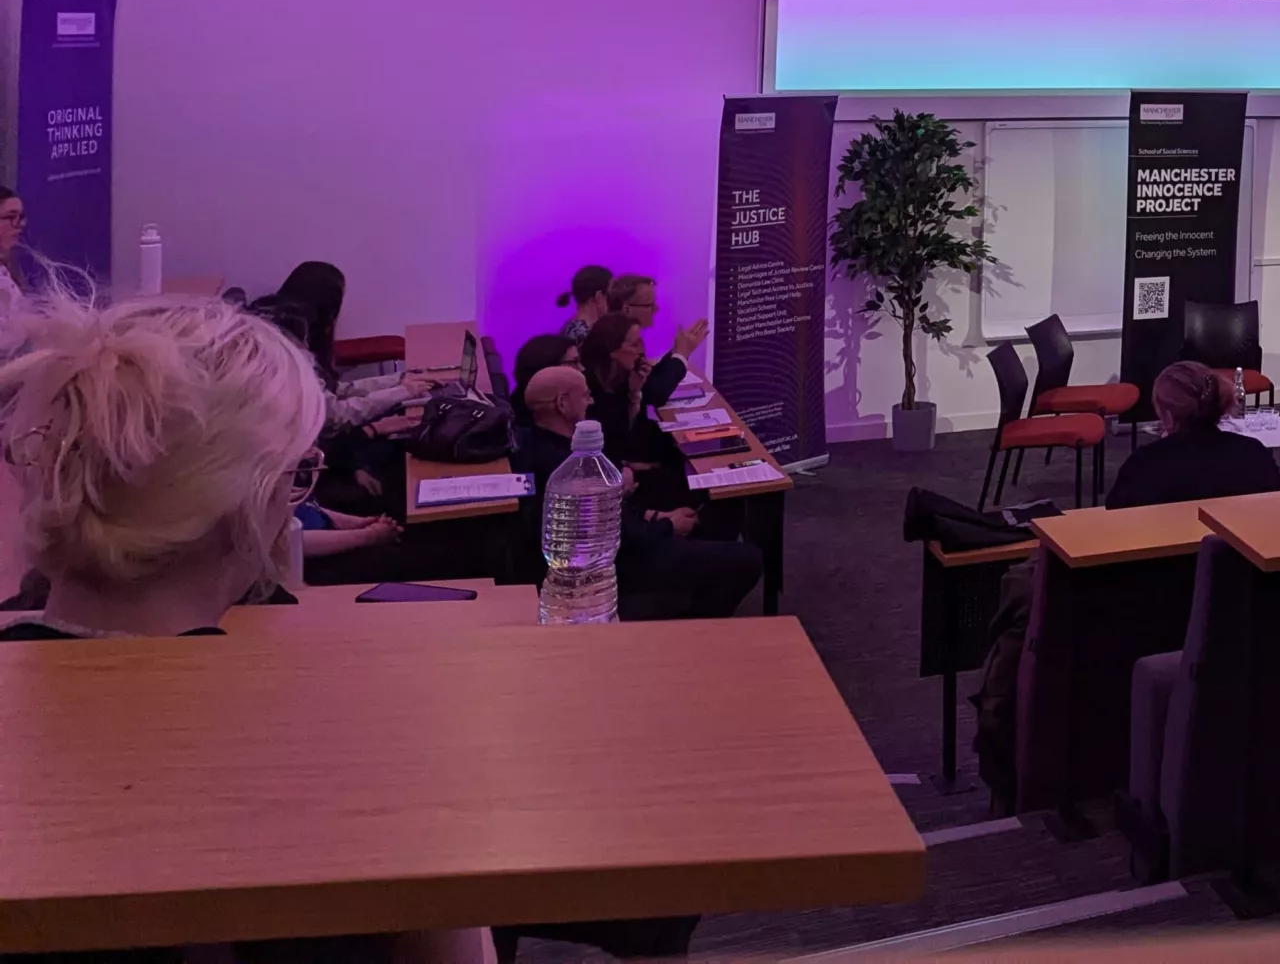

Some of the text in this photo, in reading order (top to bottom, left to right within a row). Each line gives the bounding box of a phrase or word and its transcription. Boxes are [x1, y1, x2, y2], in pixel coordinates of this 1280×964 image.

[47, 106, 103, 125] ORIGINAL
[46, 123, 103, 142] THINKING
[51, 139, 98, 160] APPLIED
[1137, 168, 1236, 183] MANCHESTER
[731, 190, 761, 205] THE
[1136, 183, 1222, 198] INNOCENCE
[1136, 198, 1201, 213] PROJECT
[731, 207, 786, 225] JUSTICE
[731, 230, 760, 246] HUB
[1135, 230, 1214, 243] Freeing the Innocent
[1135, 247, 1217, 260] Changing the System
[738, 265, 752, 273] Legal
[752, 263, 768, 271] Advice
[773, 268, 791, 276] Justice
[737, 281, 762, 290] Dementia
[737, 291, 751, 299] Legal
[795, 282, 814, 290] Justice
[737, 297, 765, 306] Manchester
[775, 293, 789, 301] Legal
[736, 303, 777, 315] Vacation Scheme
[736, 314, 757, 323] Personal
[757, 311, 777, 320] Support
[736, 323, 755, 332] Greater
[754, 319, 783, 328] Manchester
[793, 315, 812, 323] Centre
[736, 333, 755, 341] Student
[776, 325, 796, 334] Society
